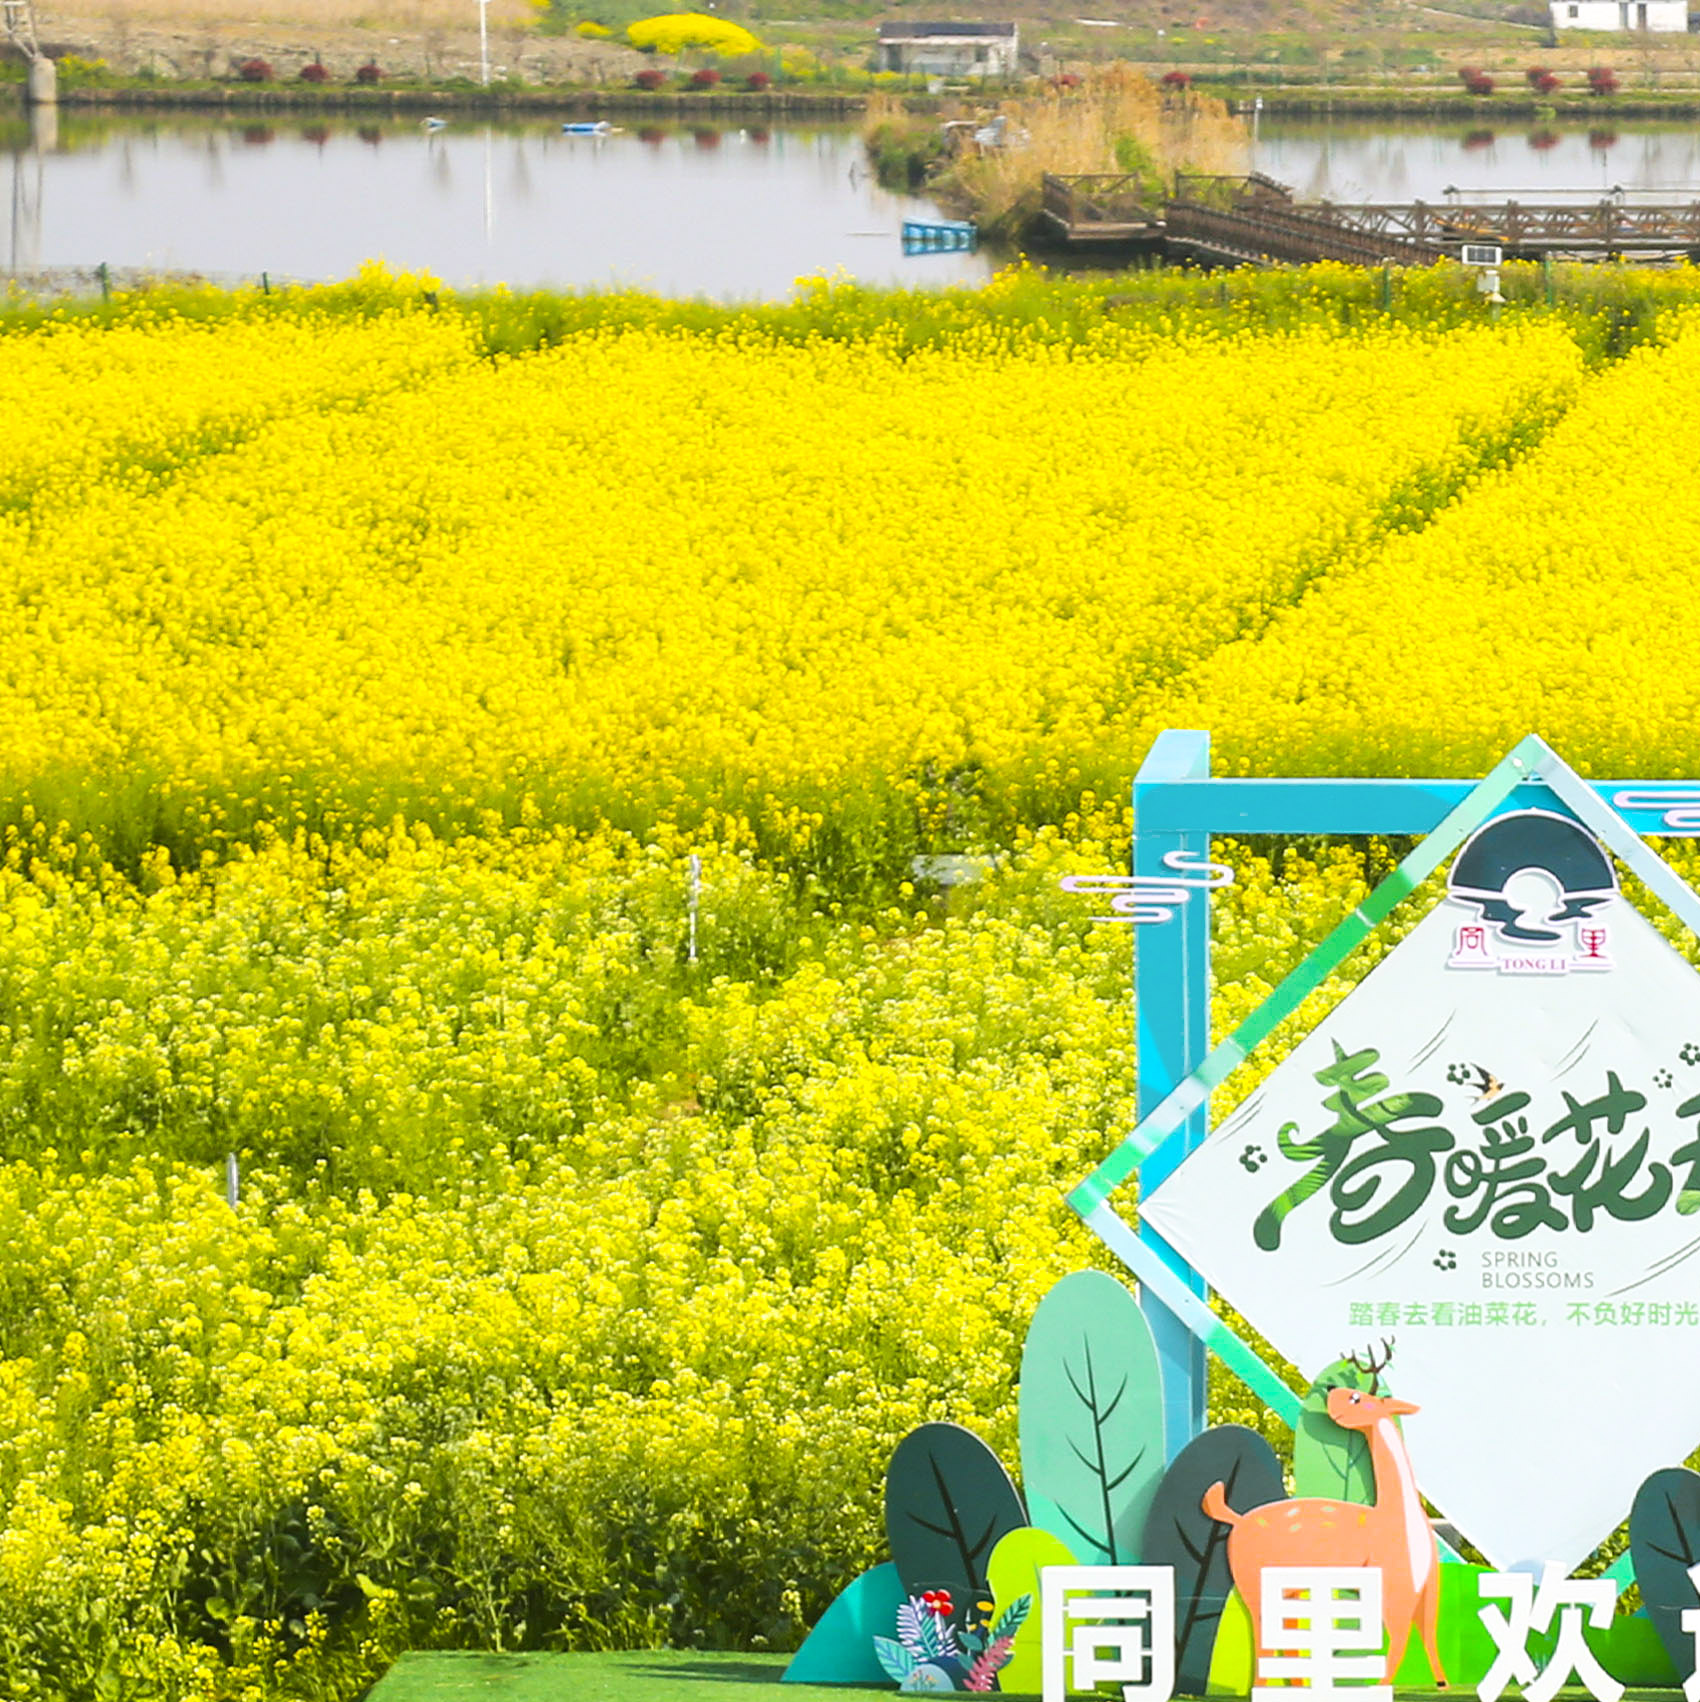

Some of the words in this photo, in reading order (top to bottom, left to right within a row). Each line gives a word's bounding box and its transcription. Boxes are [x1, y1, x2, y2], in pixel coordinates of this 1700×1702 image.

[1503, 958, 1547, 971] TONG
[1550, 959, 1567, 971] LI
[1480, 1250, 1559, 1269] SPRING
[1480, 1272, 1596, 1290] BLOSSOMS
